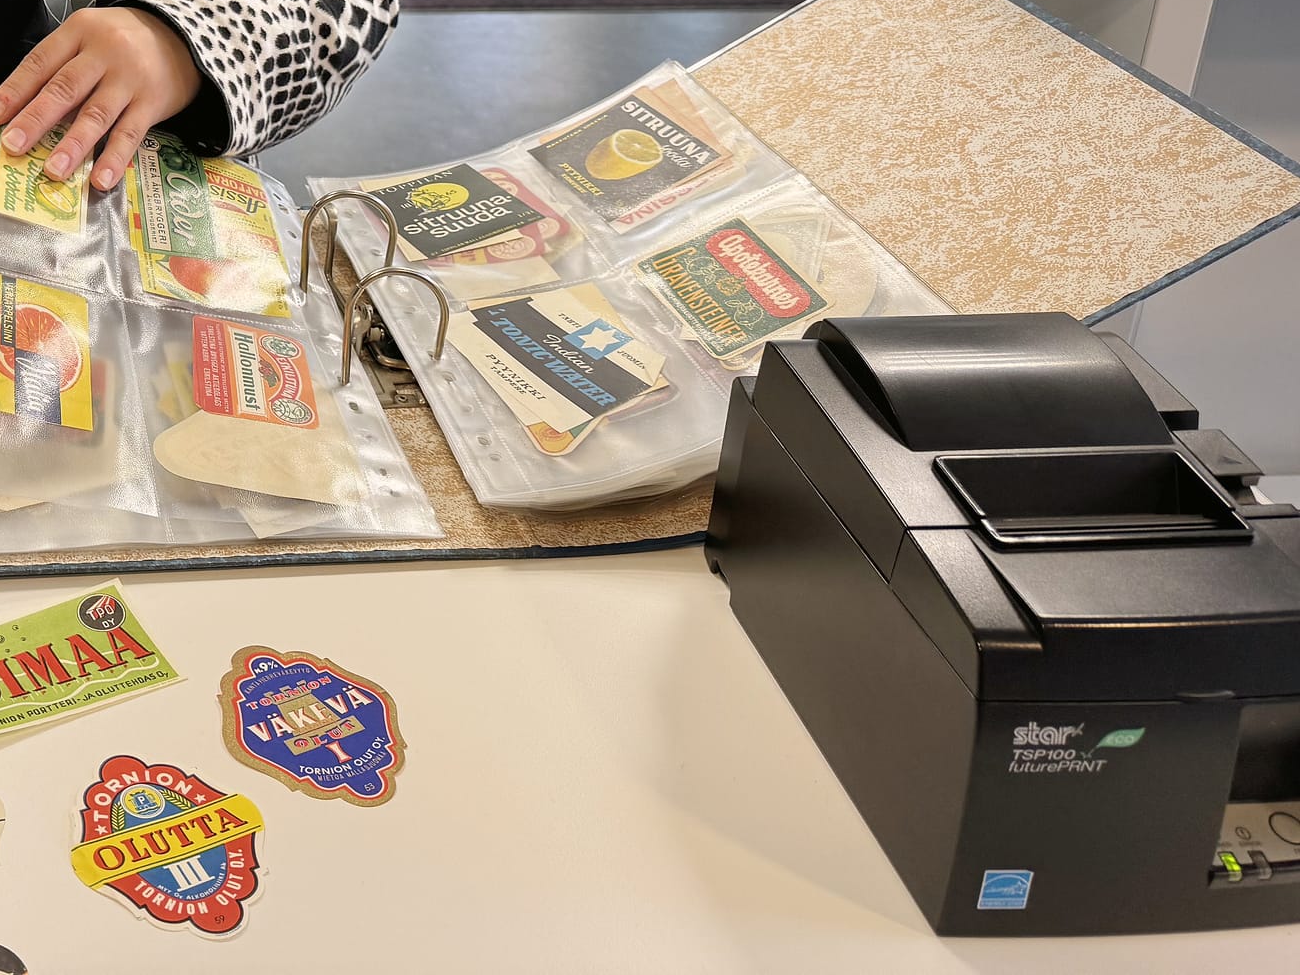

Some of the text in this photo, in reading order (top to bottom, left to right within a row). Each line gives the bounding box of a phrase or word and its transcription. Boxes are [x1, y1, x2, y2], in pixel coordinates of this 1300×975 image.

[620, 100, 712, 165] SITRUUNA
[209, 184, 266, 214] Assis
[378, 170, 453, 195] TOPPILAN
[147, 155, 167, 245] UMEÅ ÅNGBRYGGERI
[166, 172, 204, 247] Cider
[429, 206, 512, 238] suuda
[718, 234, 800, 310] Apotekarnes
[652, 246, 747, 347] GRAVENSTEINER
[490, 317, 617, 407] TONIC WATER
[542, 332, 595, 375] Indian
[233, 332, 261, 411] Hallonmust
[277, 355, 300, 399] ESKILSTUNA
[485, 352, 547, 400] PYYNIKKI
[490, 366, 528, 395] TAMPERE
[86, 604, 114, 621] TPO
[102, 619, 116, 629] OY
[96, 673, 157, 697] OLUTTEHDAS
[246, 676, 332, 710] TORNION
[246, 685, 373, 742] VÄKEVÄ
[293, 720, 355, 749] OLUT
[1013, 721, 1073, 745] star
[299, 763, 352, 775] TORNION
[354, 747, 378, 766] OLUT
[326, 741, 352, 763] I
[1008, 759, 1107, 773] futurePRNT
[1013, 749, 1076, 761] TSP100
[317, 774, 345, 782] MIETOA
[93, 770, 193, 823] TORNION
[138, 795, 145, 804] P
[93, 807, 248, 870] OLUTTA
[163, 855, 215, 892] III
[134, 881, 208, 915] TORNION
[216, 873, 244, 906] OLUT
